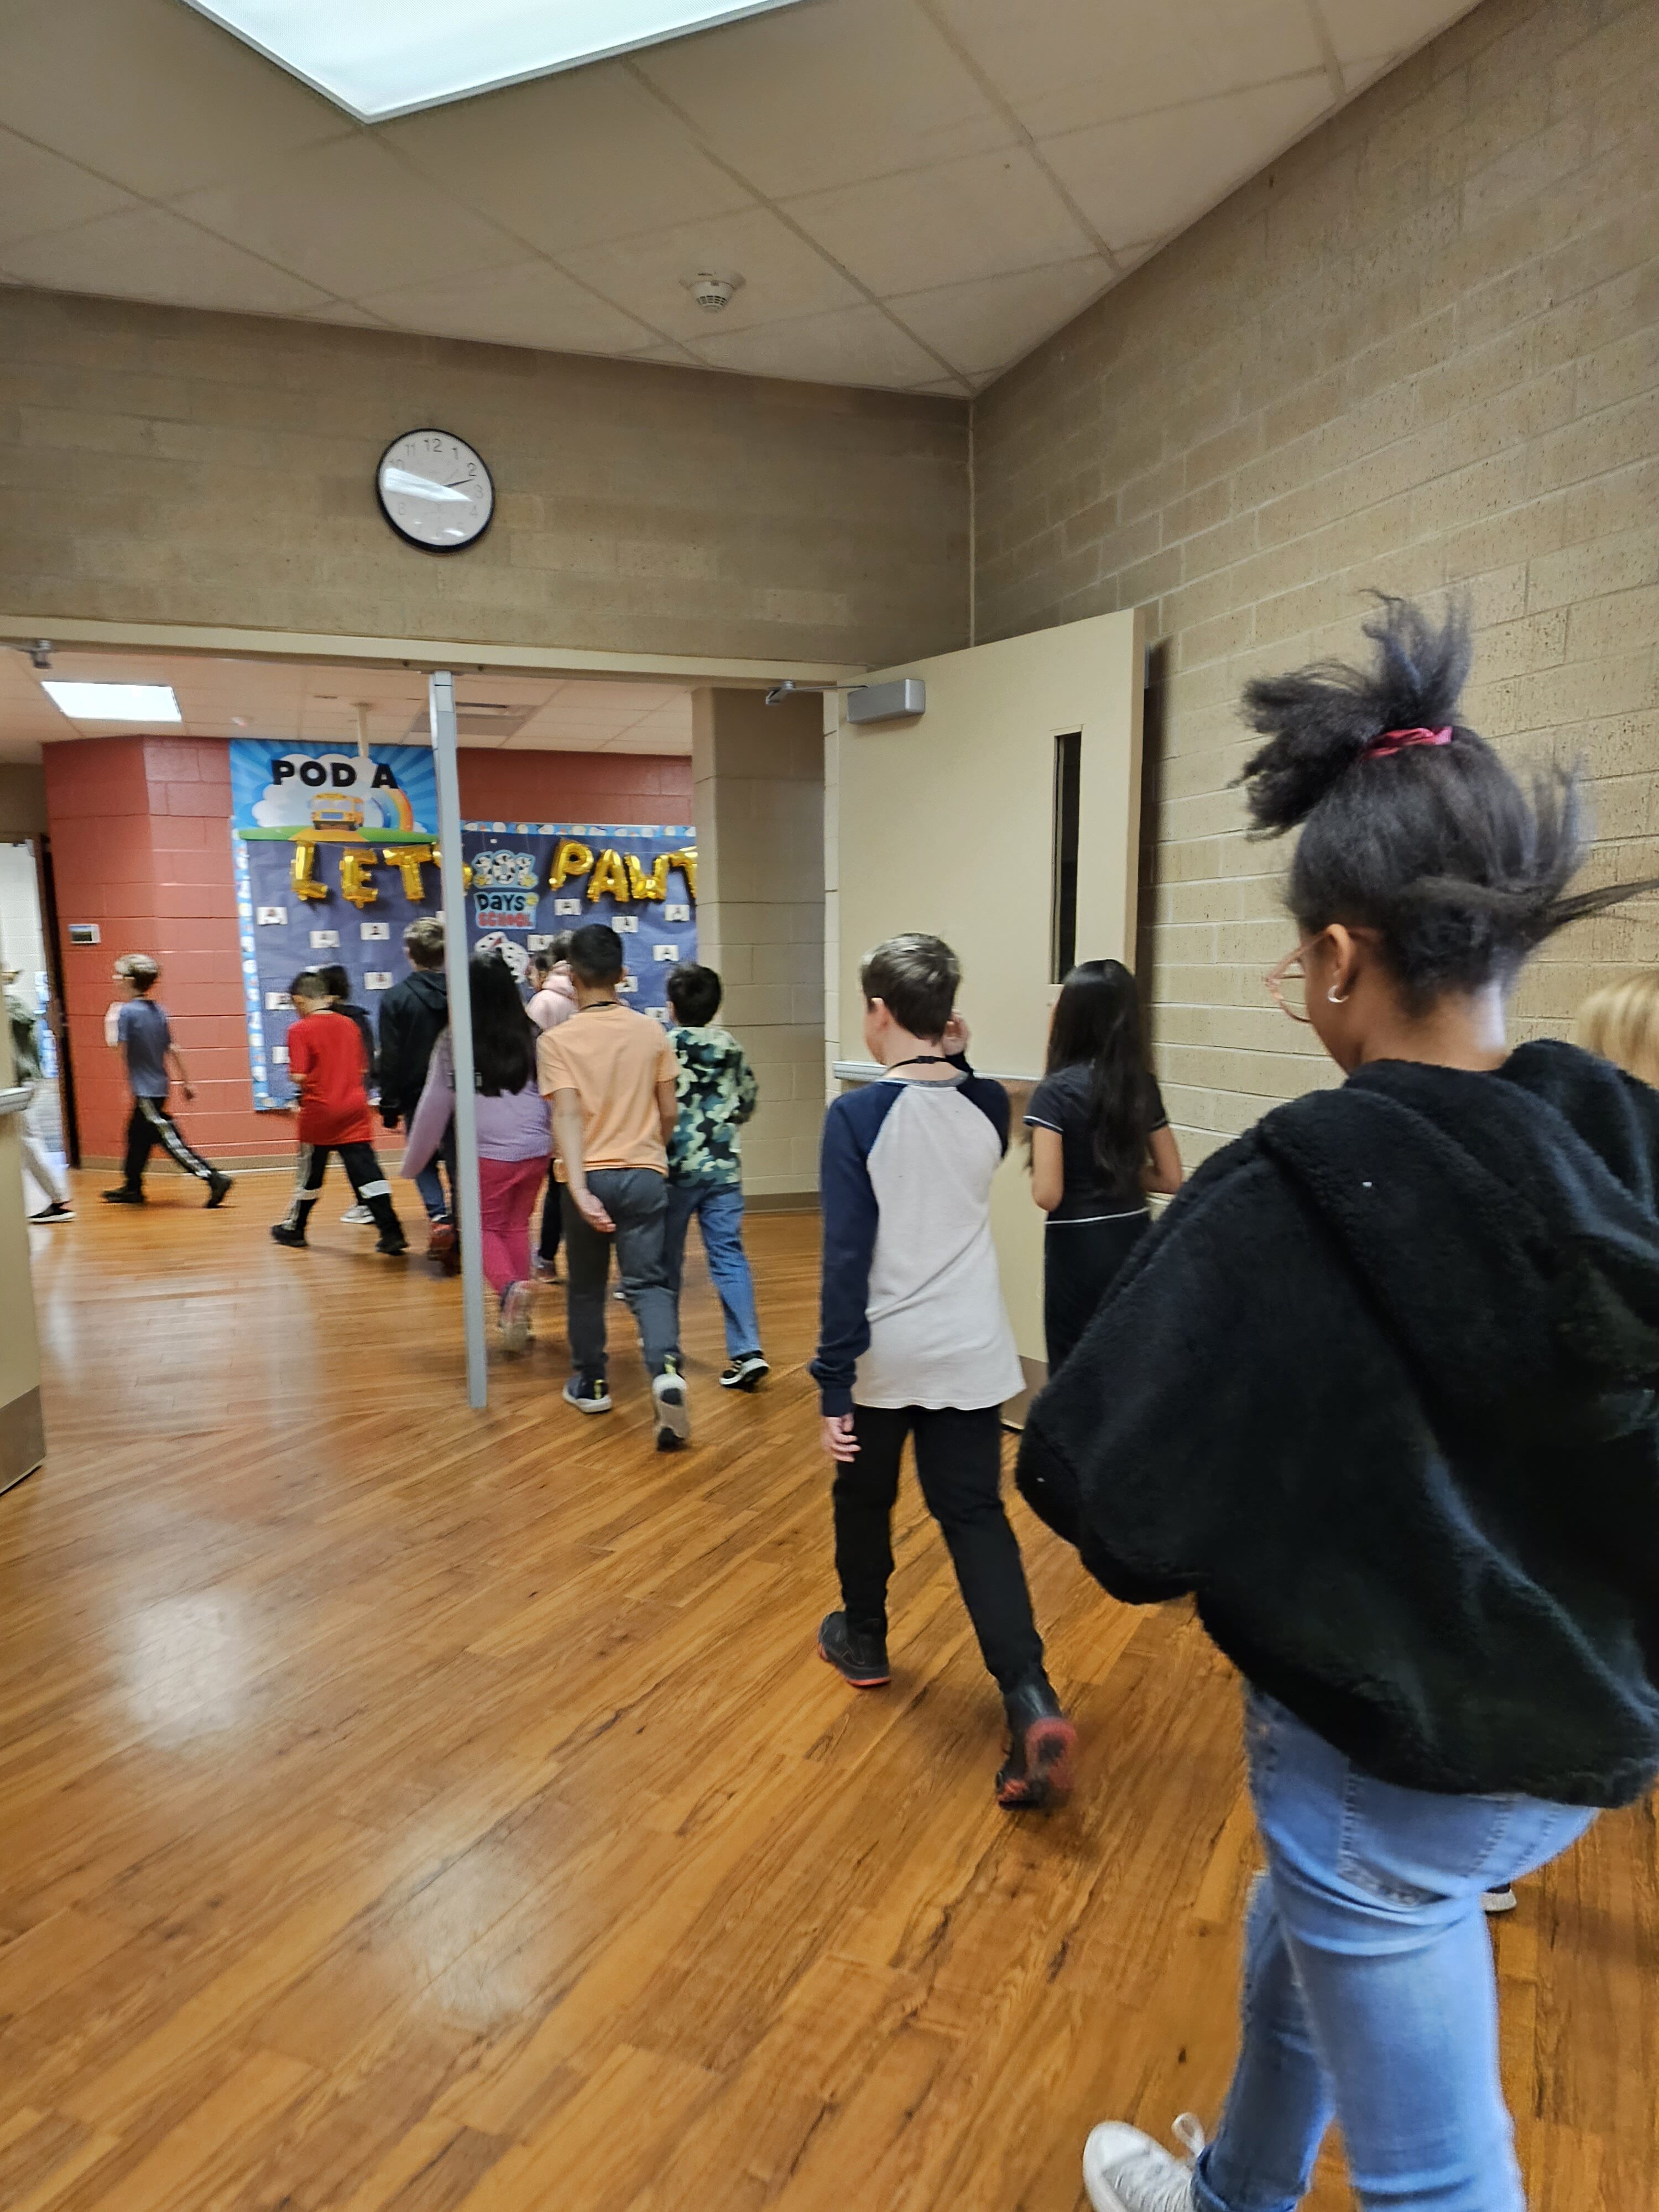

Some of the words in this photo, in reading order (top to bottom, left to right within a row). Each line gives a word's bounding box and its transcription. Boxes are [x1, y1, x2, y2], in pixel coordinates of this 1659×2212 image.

[423, 437, 443, 453] 12
[451, 446, 459, 460] 1
[467, 462, 477, 477] 2
[474, 484, 484, 499] 3
[272, 759, 357, 787] POD
[371, 763, 400, 789] A
[475, 853, 532, 886] 101
